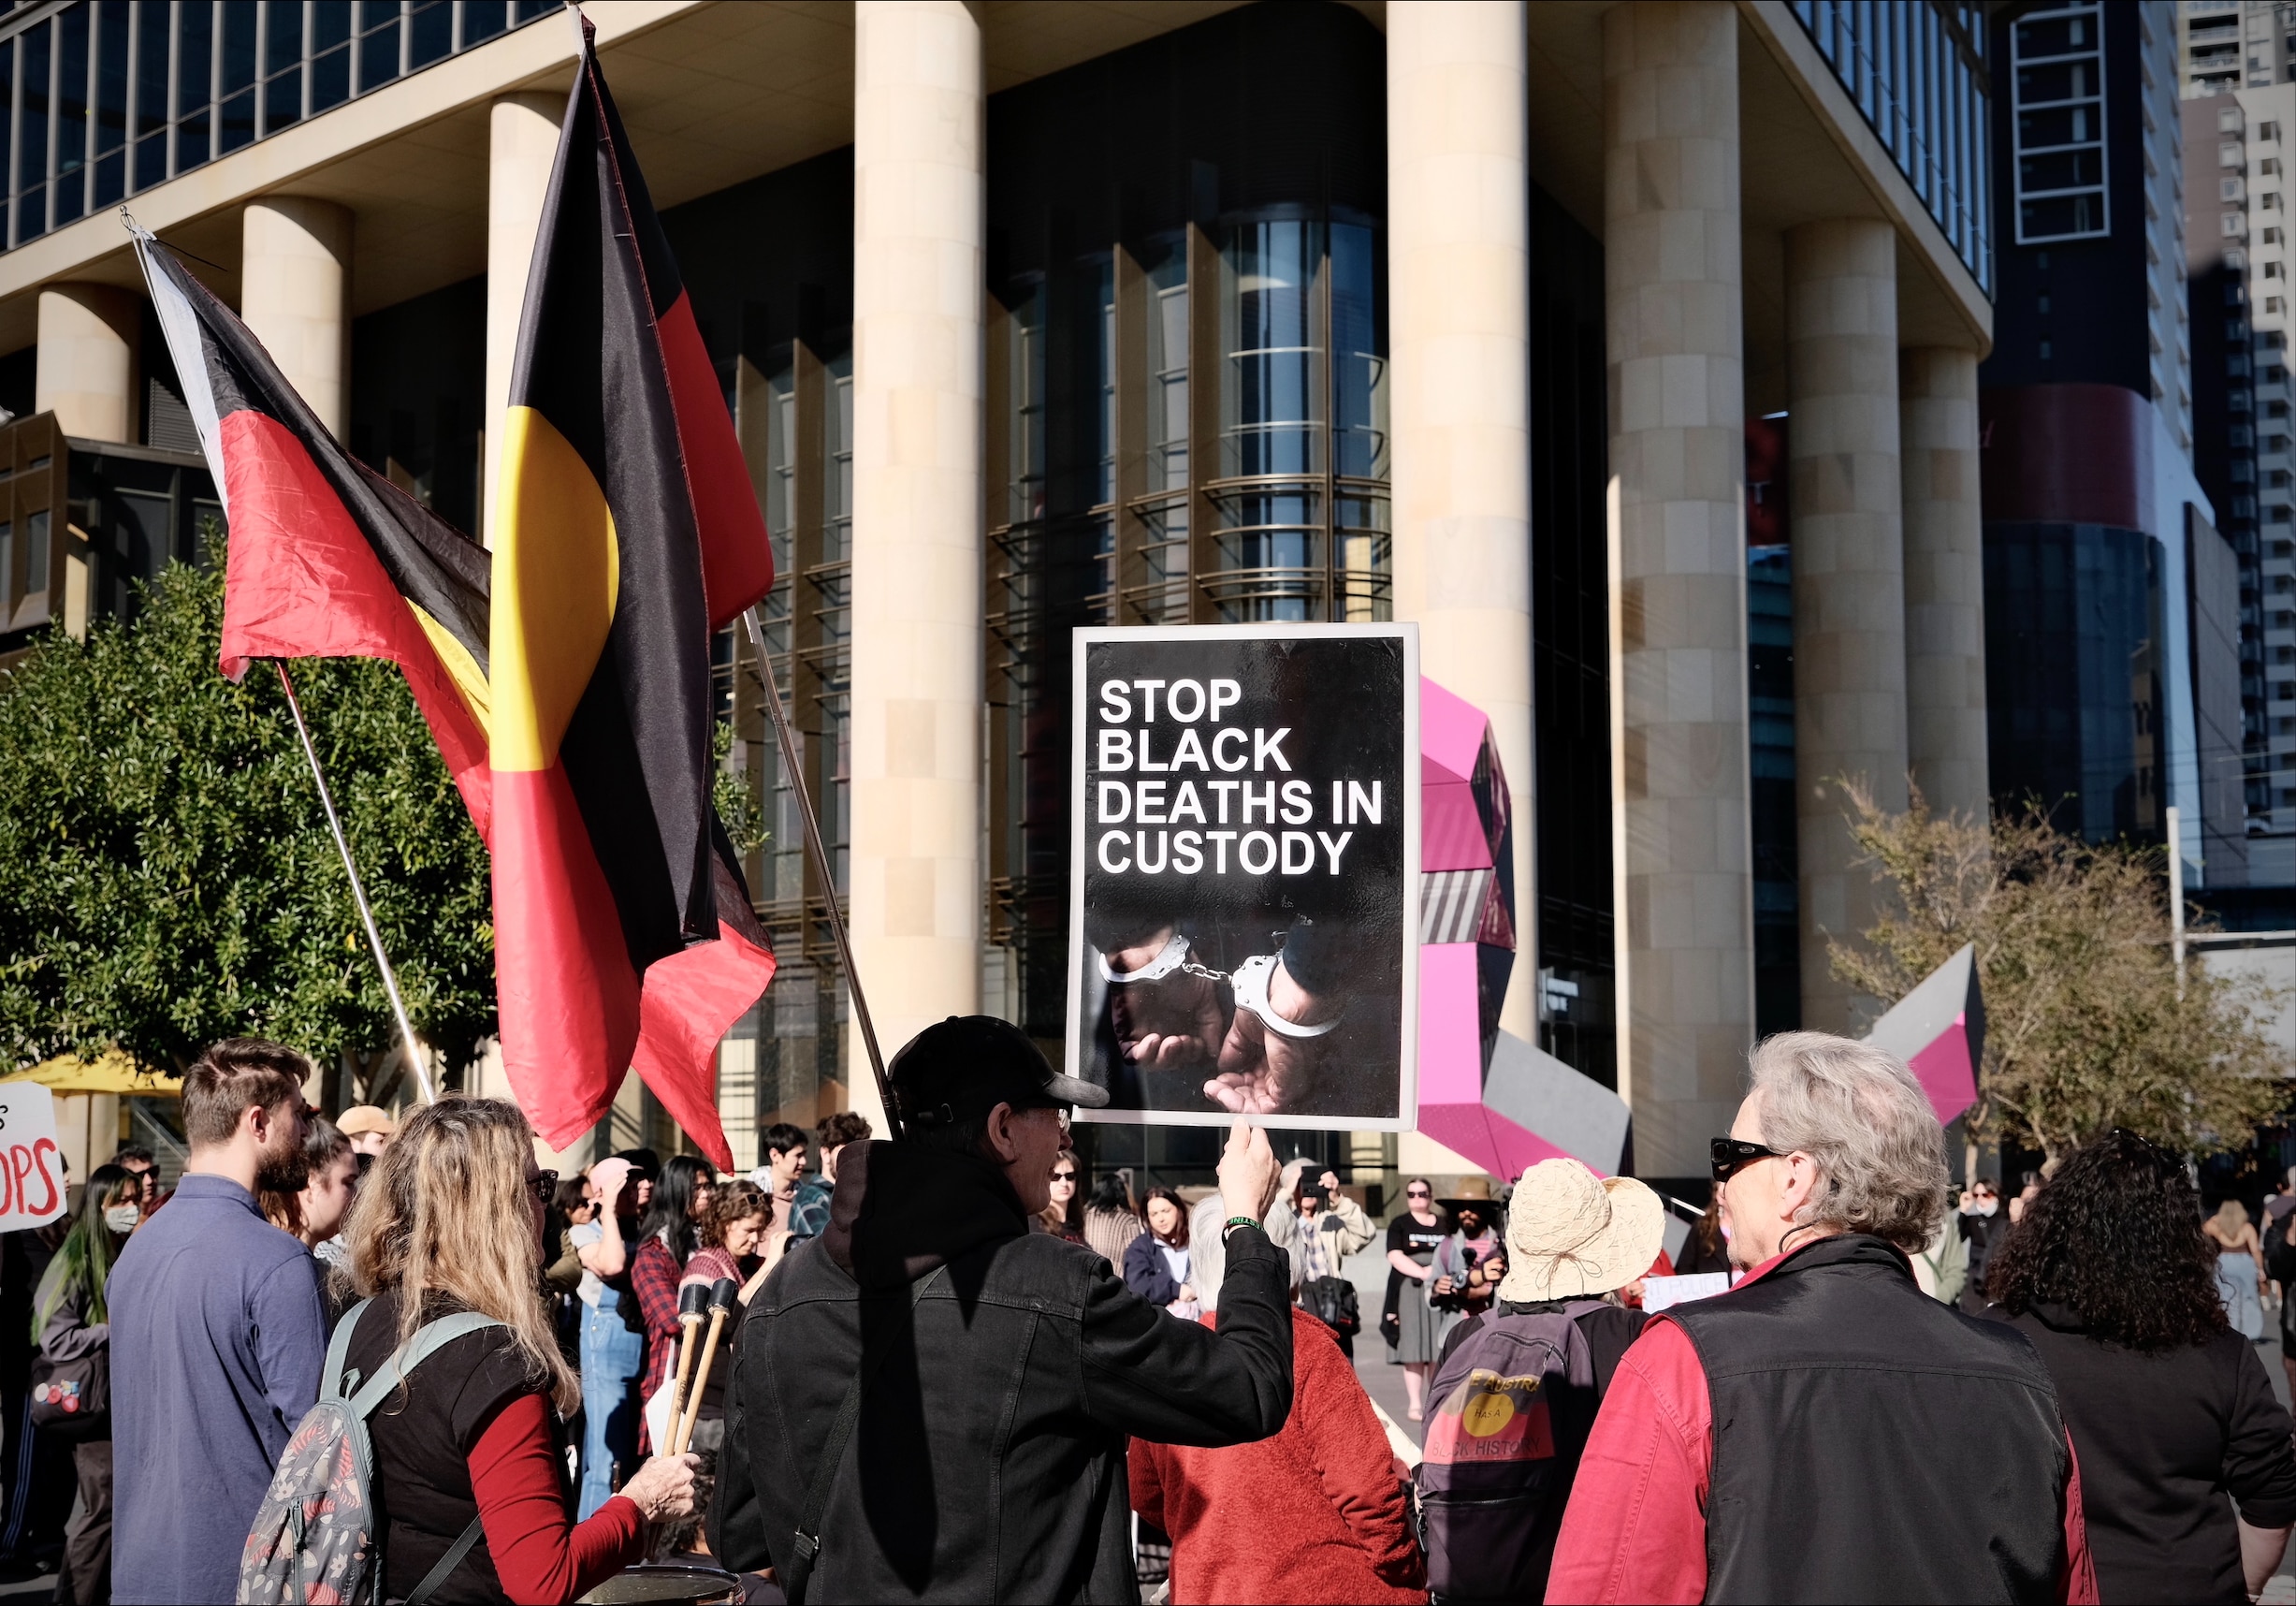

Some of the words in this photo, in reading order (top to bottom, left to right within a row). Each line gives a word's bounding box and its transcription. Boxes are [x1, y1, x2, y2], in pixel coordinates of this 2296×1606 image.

[1098, 678, 1242, 724] STOP
[1097, 727, 1293, 773] BLACK
[1097, 780, 1314, 825] DEATHS
[1332, 780, 1382, 825] IN
[1097, 829, 1354, 876] CUSTODY
[1668, 1276, 1724, 1296] POLICE
[1474, 1408, 1493, 1419] HAS
[1493, 1408, 1501, 1417] A
[1431, 1440, 1469, 1458] BLCK
[1475, 1437, 1541, 1456] HISTORY
